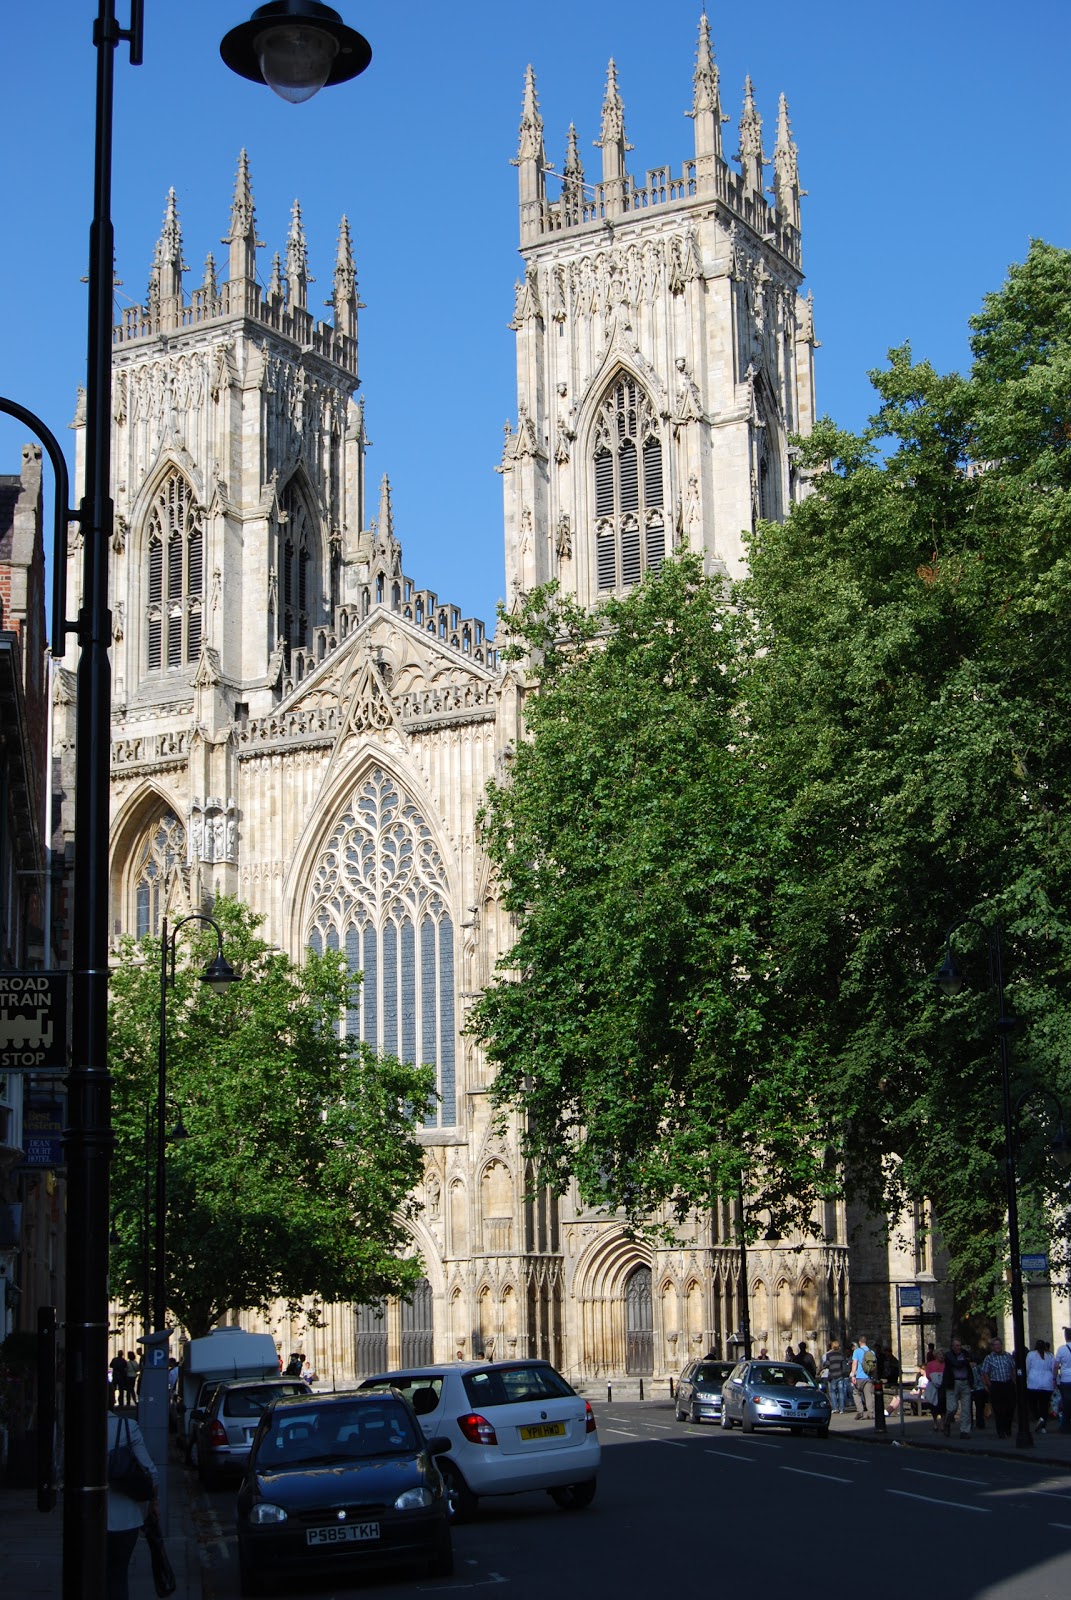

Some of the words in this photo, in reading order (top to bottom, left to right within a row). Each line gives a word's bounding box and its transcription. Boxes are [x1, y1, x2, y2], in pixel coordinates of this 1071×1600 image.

[0, 977, 50, 991] ROAD
[0, 993, 52, 1007] TRAIN
[1, 1052, 46, 1066] STOP
[29, 1139, 51, 1147] DEAN
[27, 1147, 52, 1155] COURT
[27, 1155, 52, 1163] HOTEL
[153, 1349, 165, 1366] P
[526, 1427, 542, 1438] YP11
[308, 1527, 347, 1543] P585
[350, 1523, 379, 1539] TKH
